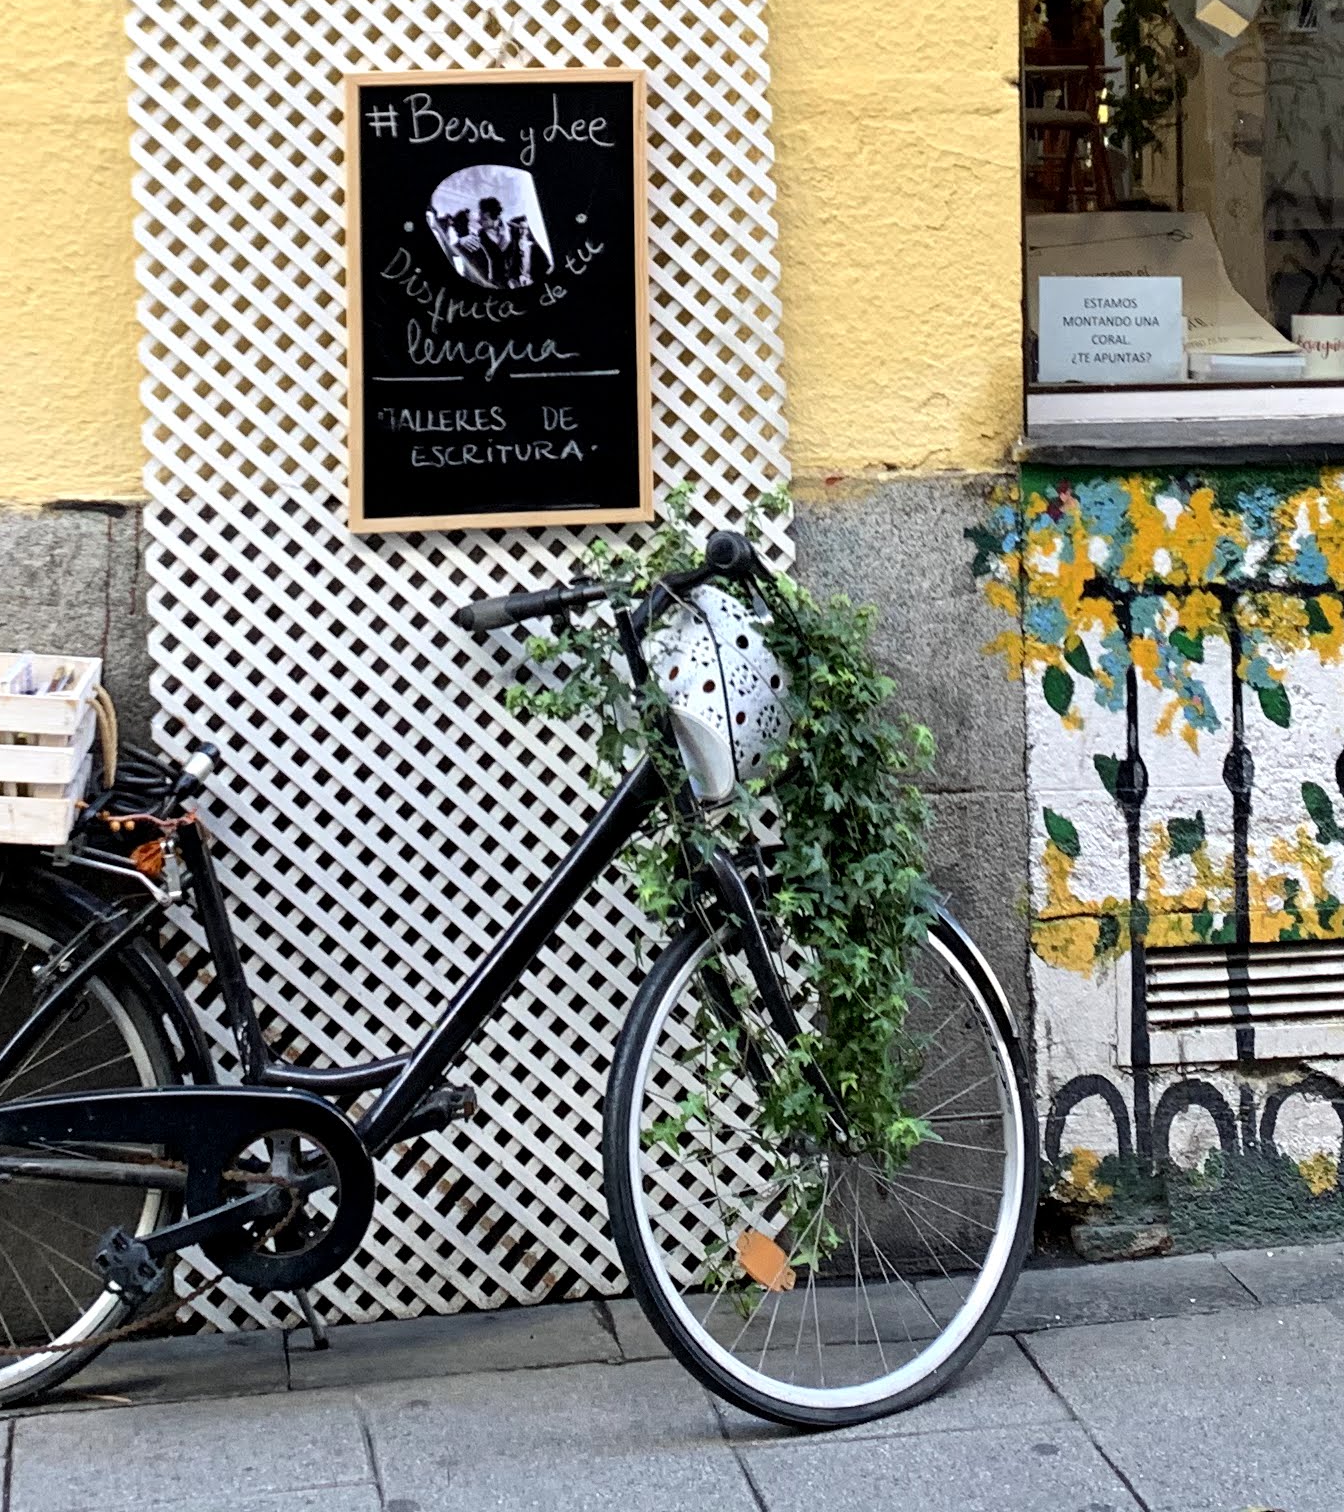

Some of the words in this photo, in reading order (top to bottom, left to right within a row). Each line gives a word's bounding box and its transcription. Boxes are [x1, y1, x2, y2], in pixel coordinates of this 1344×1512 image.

[364, 92, 506, 144] #Besa
[519, 126, 536, 167] y
[542, 92, 616, 147] Lee
[380, 246, 528, 335] Disfruta
[539, 282, 568, 307] de
[564, 238, 605, 275] tu
[1083, 297, 1138, 310] ESTAMOS
[1062, 315, 1132, 328] MONTANDO
[1134, 315, 1160, 328] UNA
[407, 318, 581, 382] lengua
[1071, 352, 1090, 365] ¿TE
[1093, 351, 1153, 365] APUNTAS?
[541, 406, 579, 432] DE
